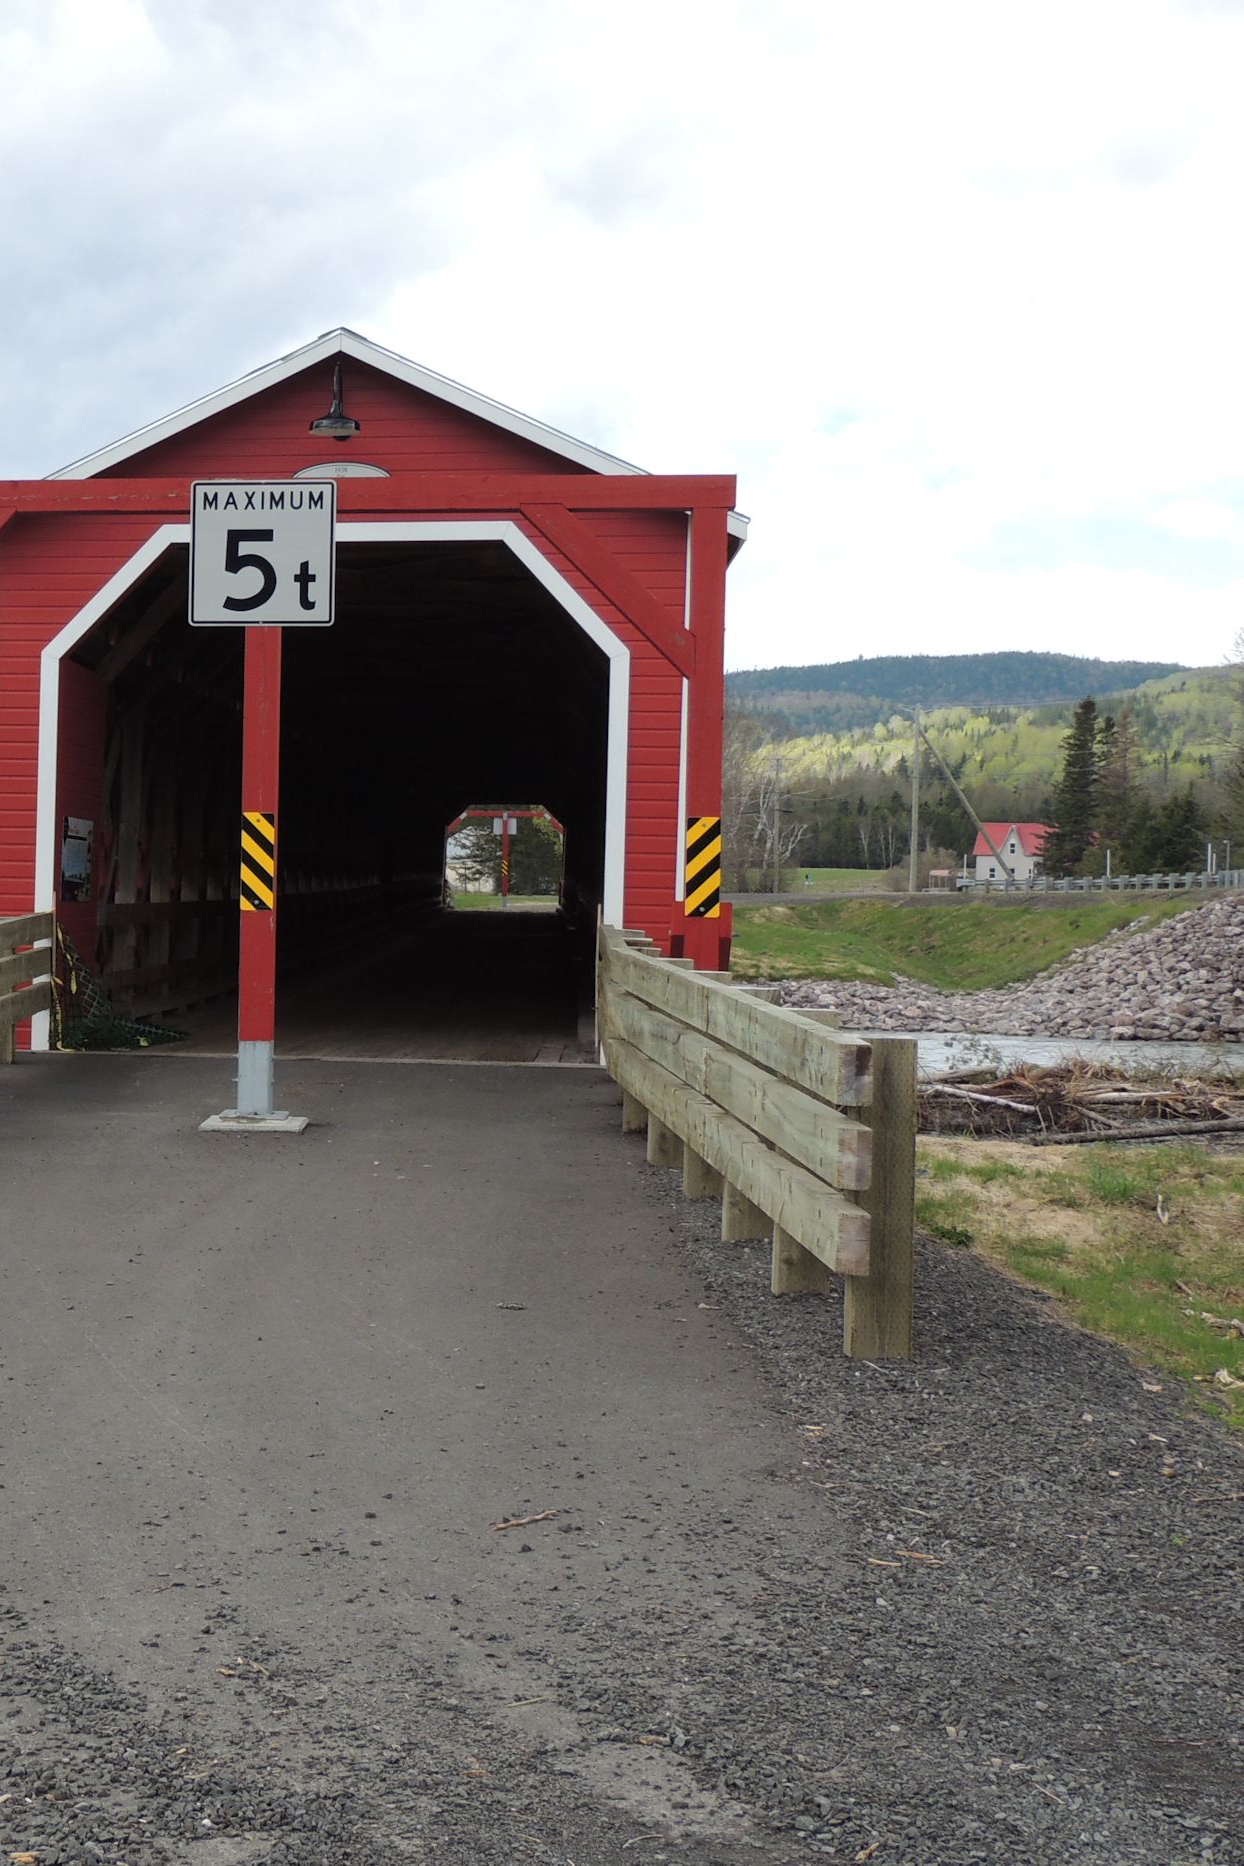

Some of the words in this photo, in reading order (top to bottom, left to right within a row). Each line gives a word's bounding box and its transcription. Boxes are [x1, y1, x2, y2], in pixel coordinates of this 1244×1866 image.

[203, 490, 324, 511] MAXIMUM
[222, 529, 277, 612] 5
[294, 560, 316, 611] t
